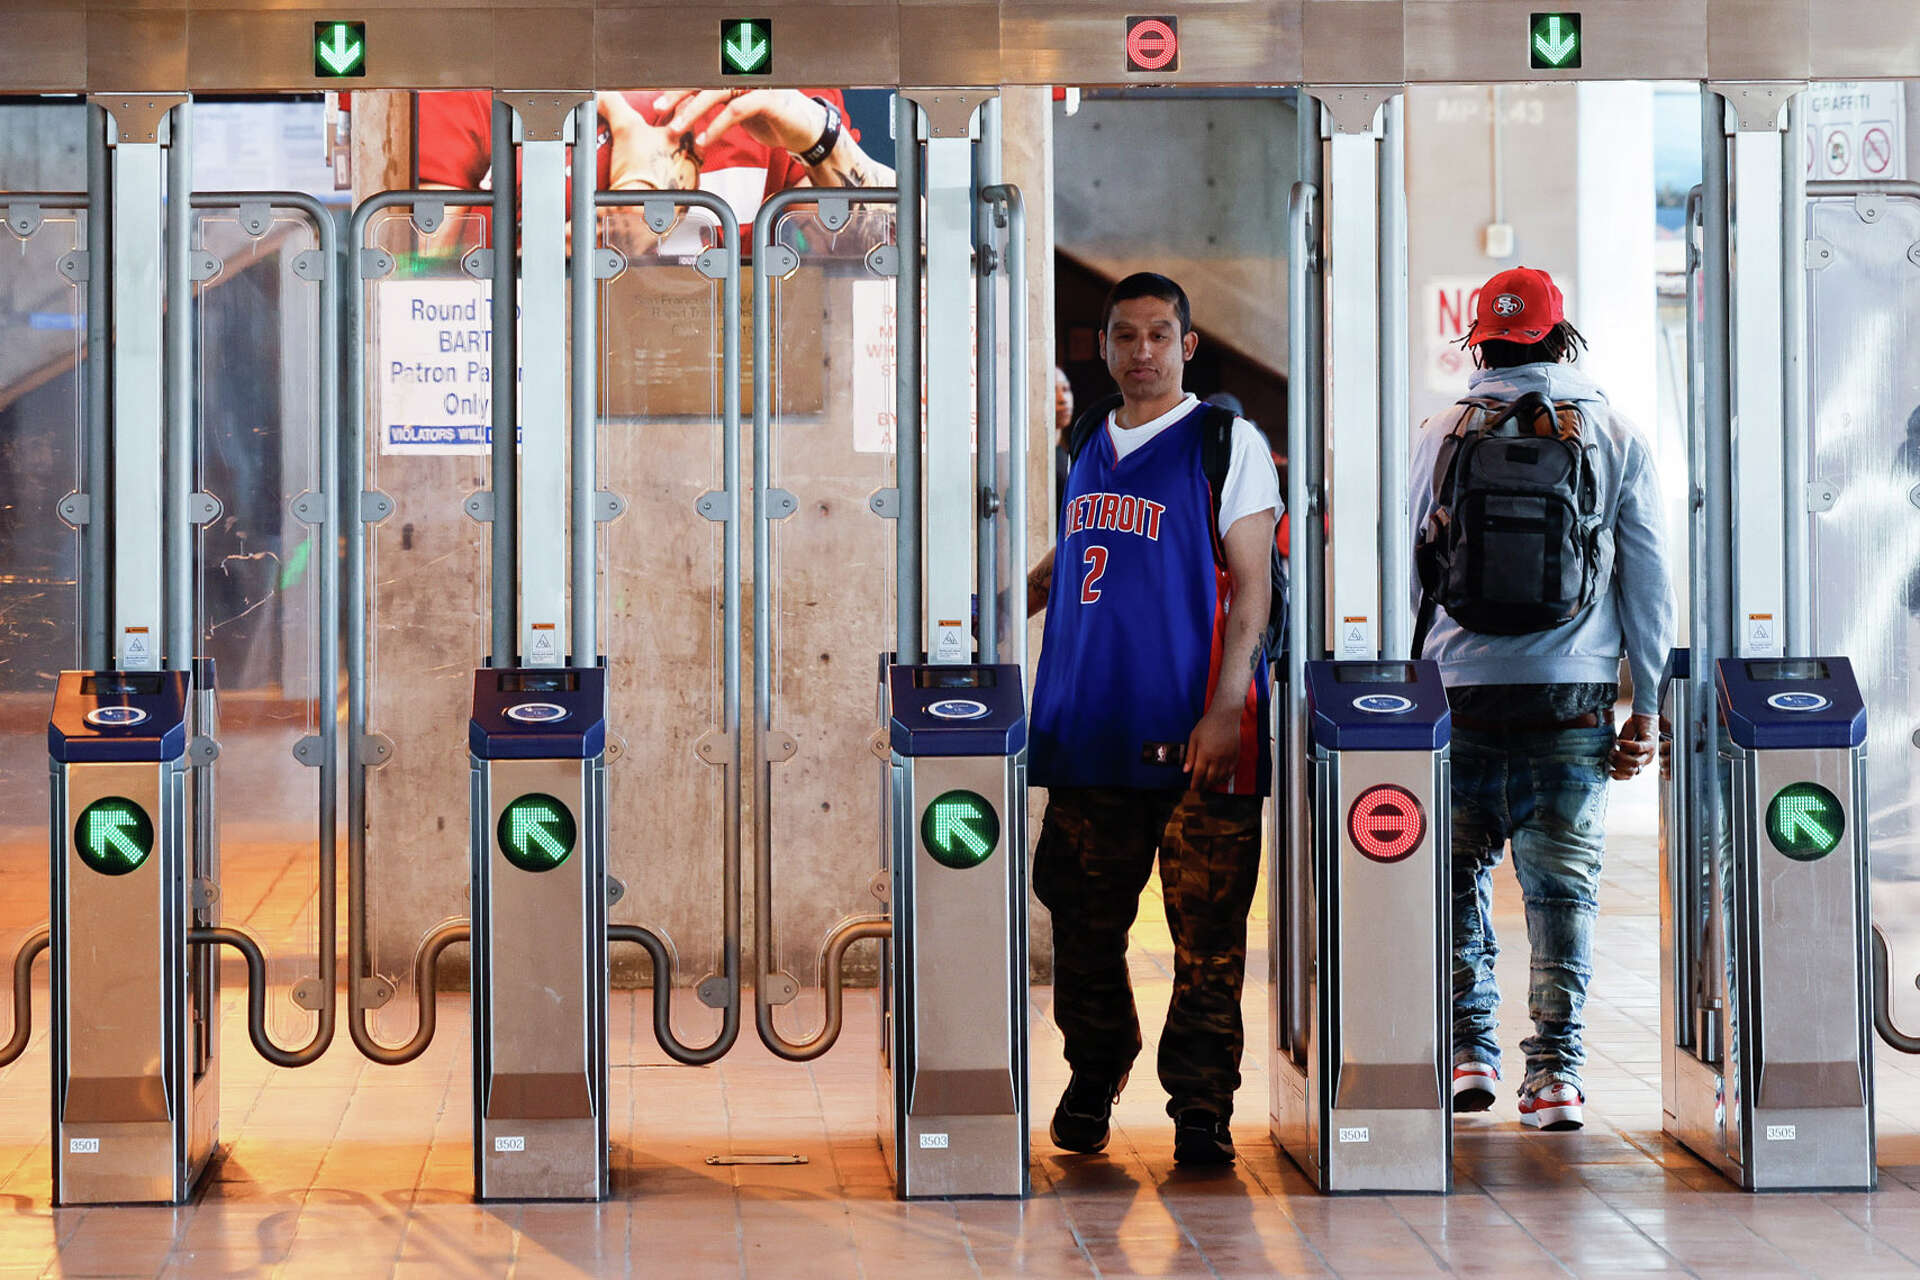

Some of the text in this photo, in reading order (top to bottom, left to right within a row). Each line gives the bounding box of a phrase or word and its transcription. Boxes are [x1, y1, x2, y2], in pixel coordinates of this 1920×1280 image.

[1812, 94, 1870, 112] GRAFFITI
[412, 299, 476, 321] Round
[440, 331, 493, 352] BART
[391, 361, 456, 382] Patron
[445, 393, 489, 419] Only
[1080, 545, 1109, 604] 2
[496, 1138, 523, 1149] 3502
[921, 1135, 947, 1146] 3503
[1341, 1129, 1367, 1140] 3504
[72, 1140, 97, 1151] 3501
